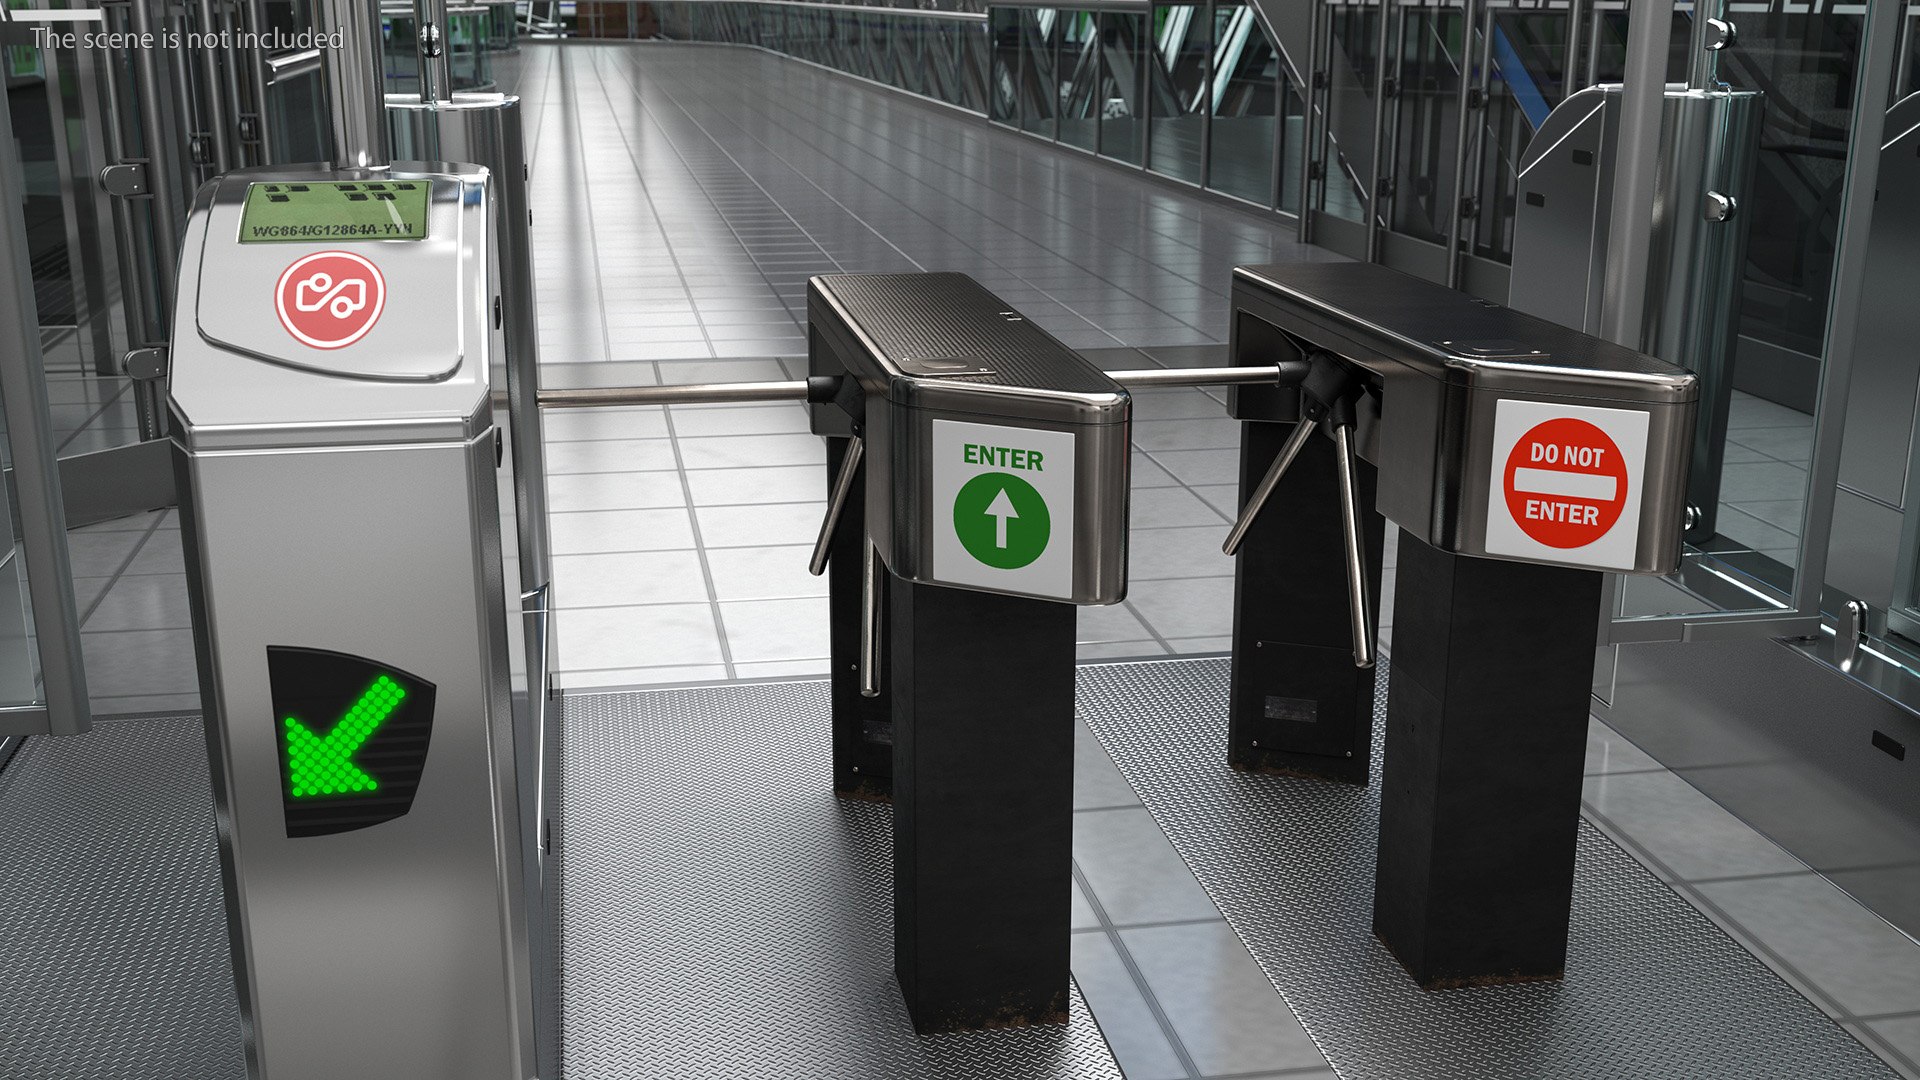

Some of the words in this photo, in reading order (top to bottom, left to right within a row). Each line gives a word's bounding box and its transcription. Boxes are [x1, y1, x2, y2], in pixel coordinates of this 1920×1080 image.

[963, 443, 1044, 471] ENTER
[1531, 442, 1559, 464] DO
[1563, 445, 1605, 468] NOT
[1525, 499, 1599, 526] ENTER
